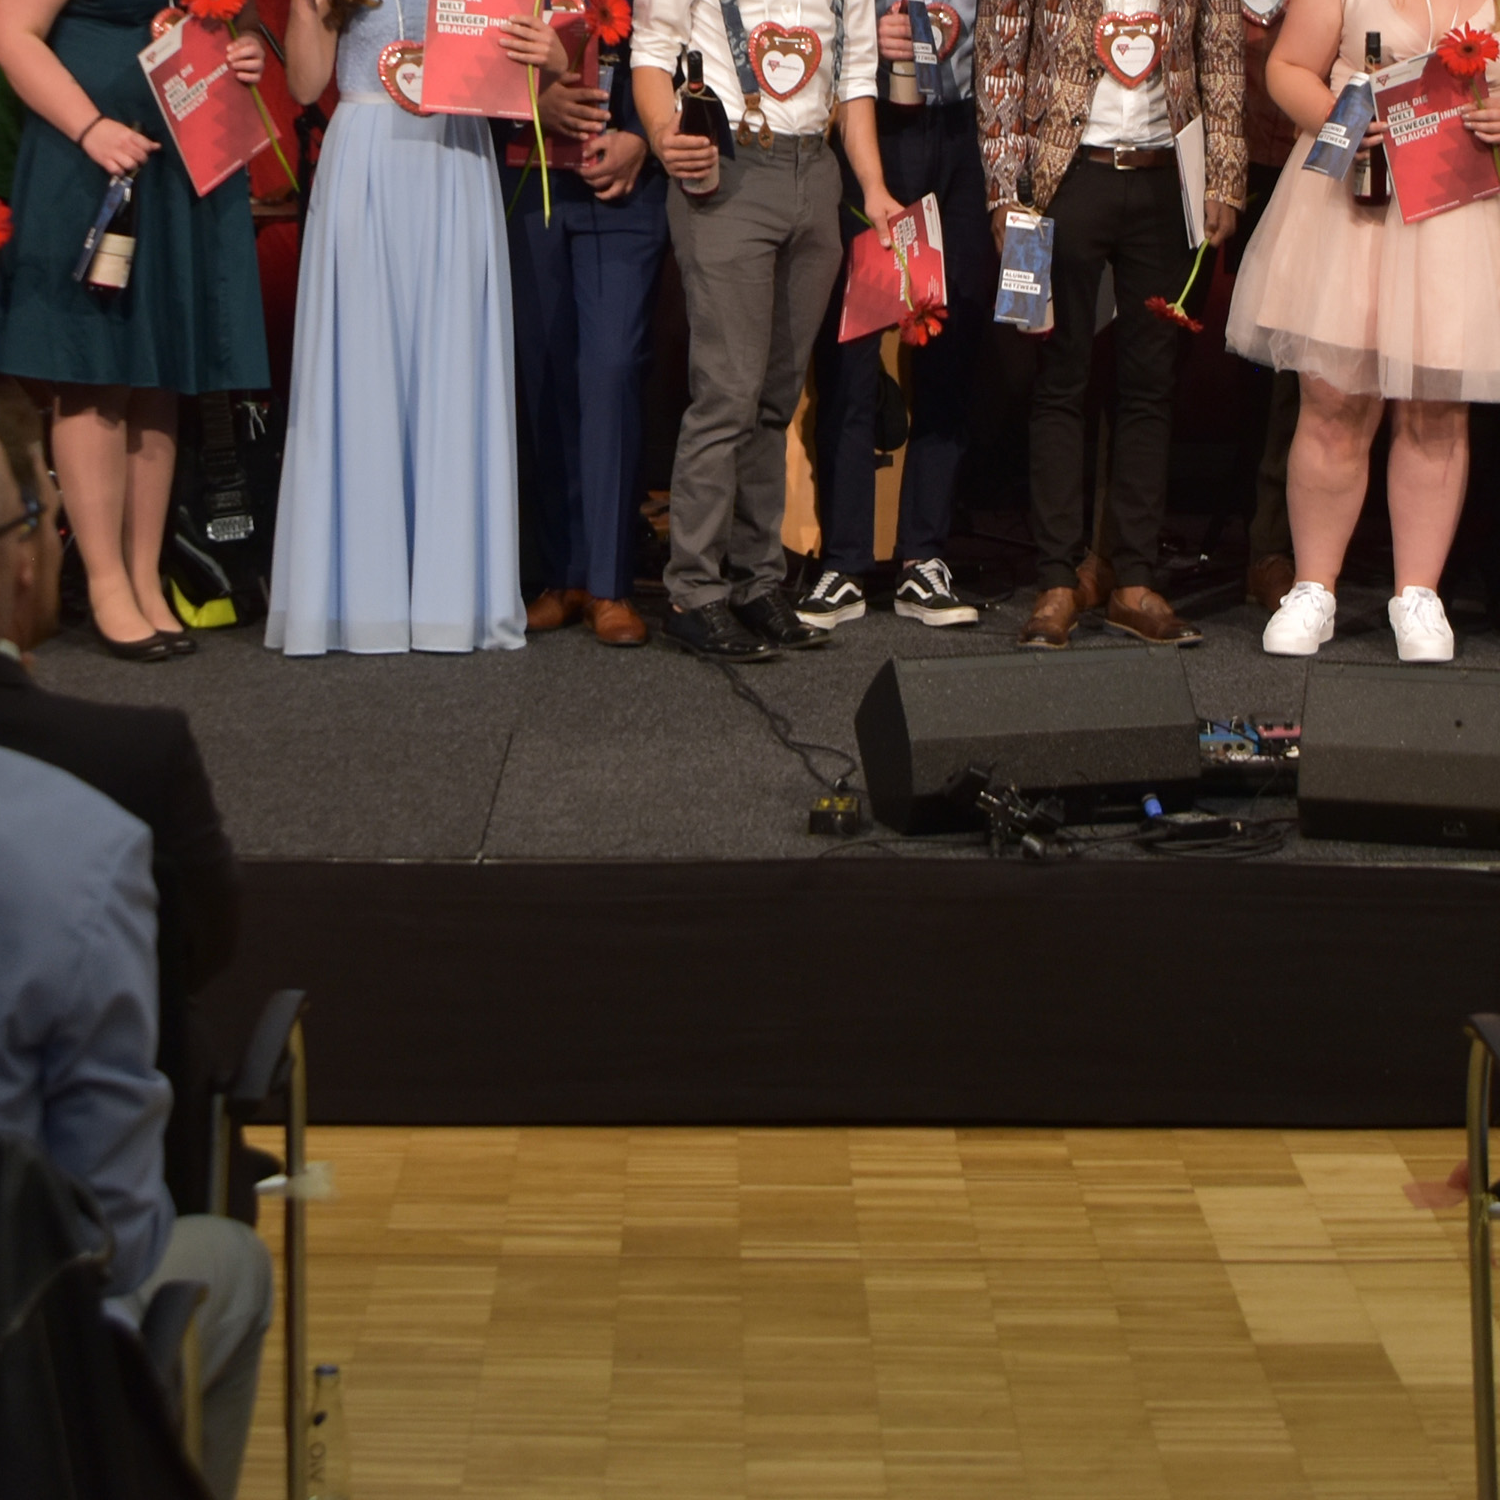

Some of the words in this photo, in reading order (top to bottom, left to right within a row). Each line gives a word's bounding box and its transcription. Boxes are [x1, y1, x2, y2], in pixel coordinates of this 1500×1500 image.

[439, 1, 463, 11] WELT
[438, 13, 486, 26] BEWEGER
[437, 25, 485, 36] BRAUCHT
[1387, 101, 1412, 115] WEIL
[1412, 94, 1429, 108] DIE
[1389, 110, 1413, 124] WELT
[1391, 113, 1439, 137] BEWEGER
[1440, 106, 1465, 120] INNE
[1394, 125, 1439, 147] BRAUCHT
